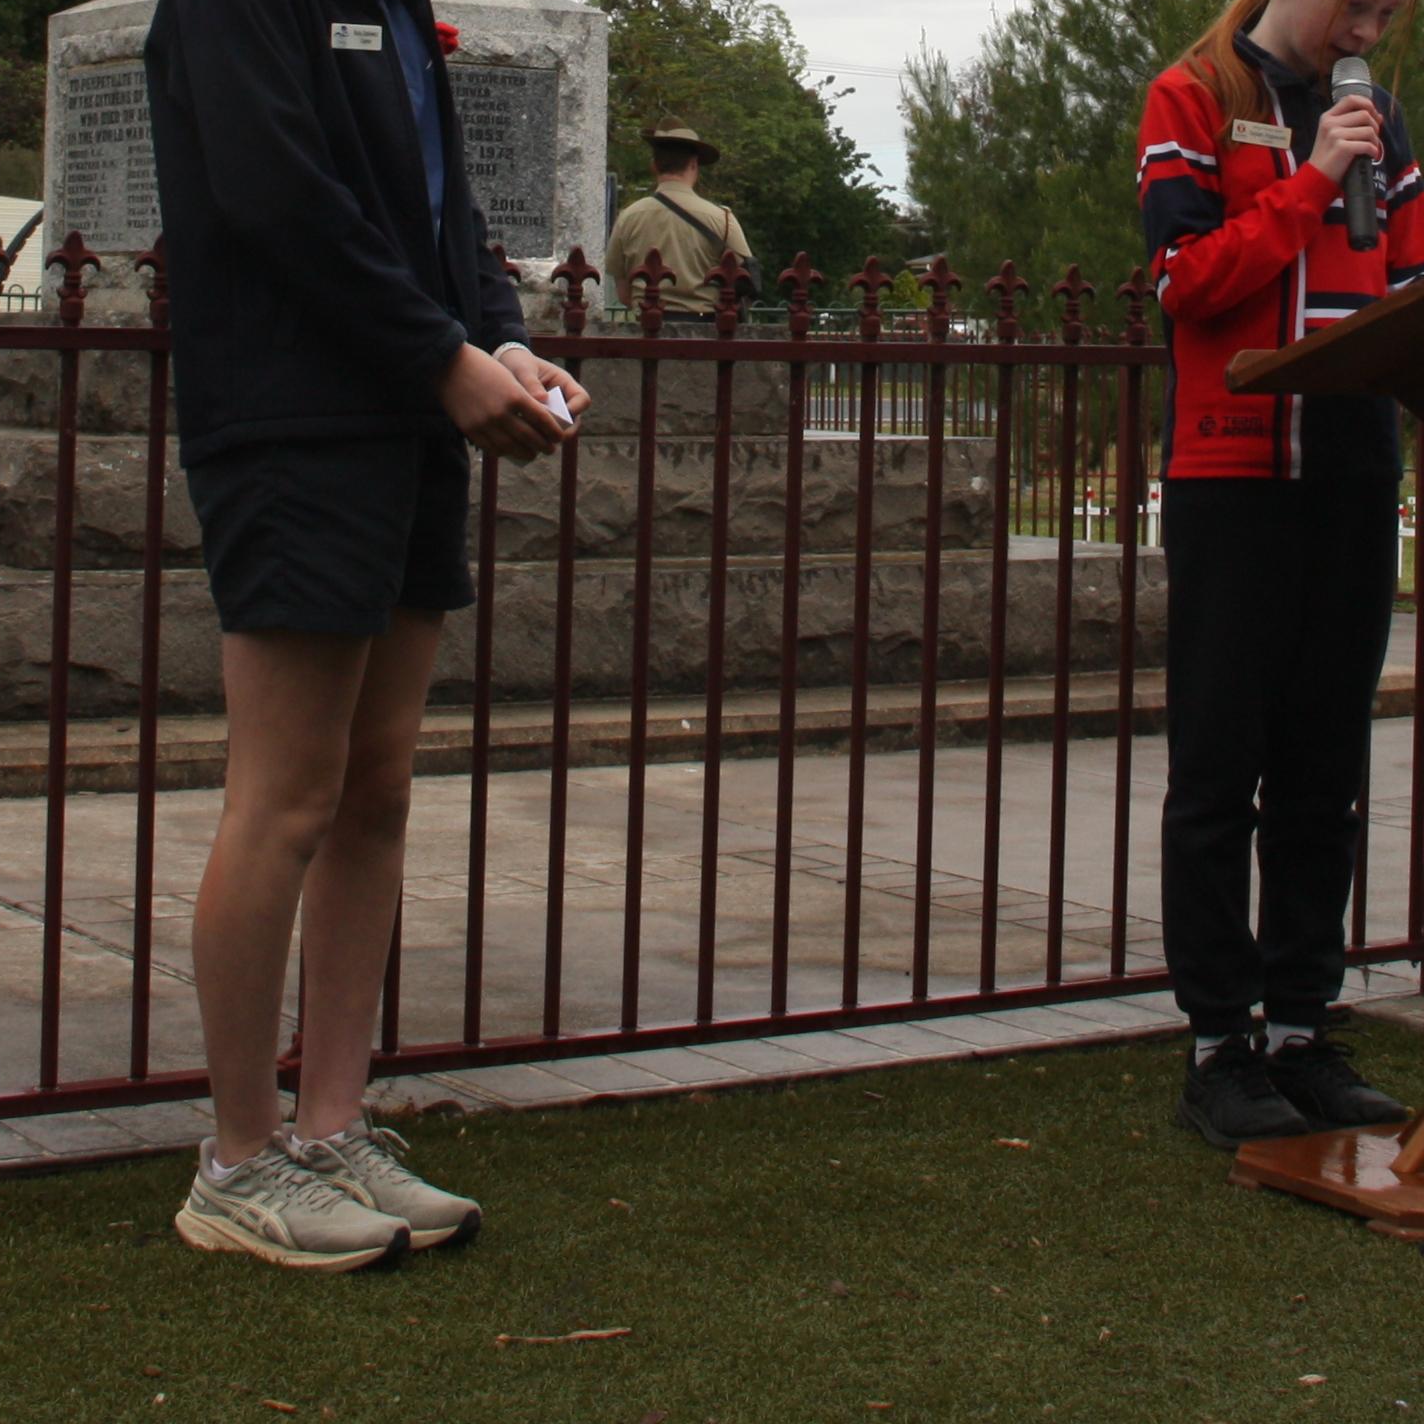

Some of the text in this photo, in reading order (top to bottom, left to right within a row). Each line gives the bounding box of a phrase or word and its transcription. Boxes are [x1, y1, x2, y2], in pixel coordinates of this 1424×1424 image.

[95, 90, 131, 107] CITIZENS
[95, 127, 123, 143] WORLD
[489, 198, 525, 212] 2013
